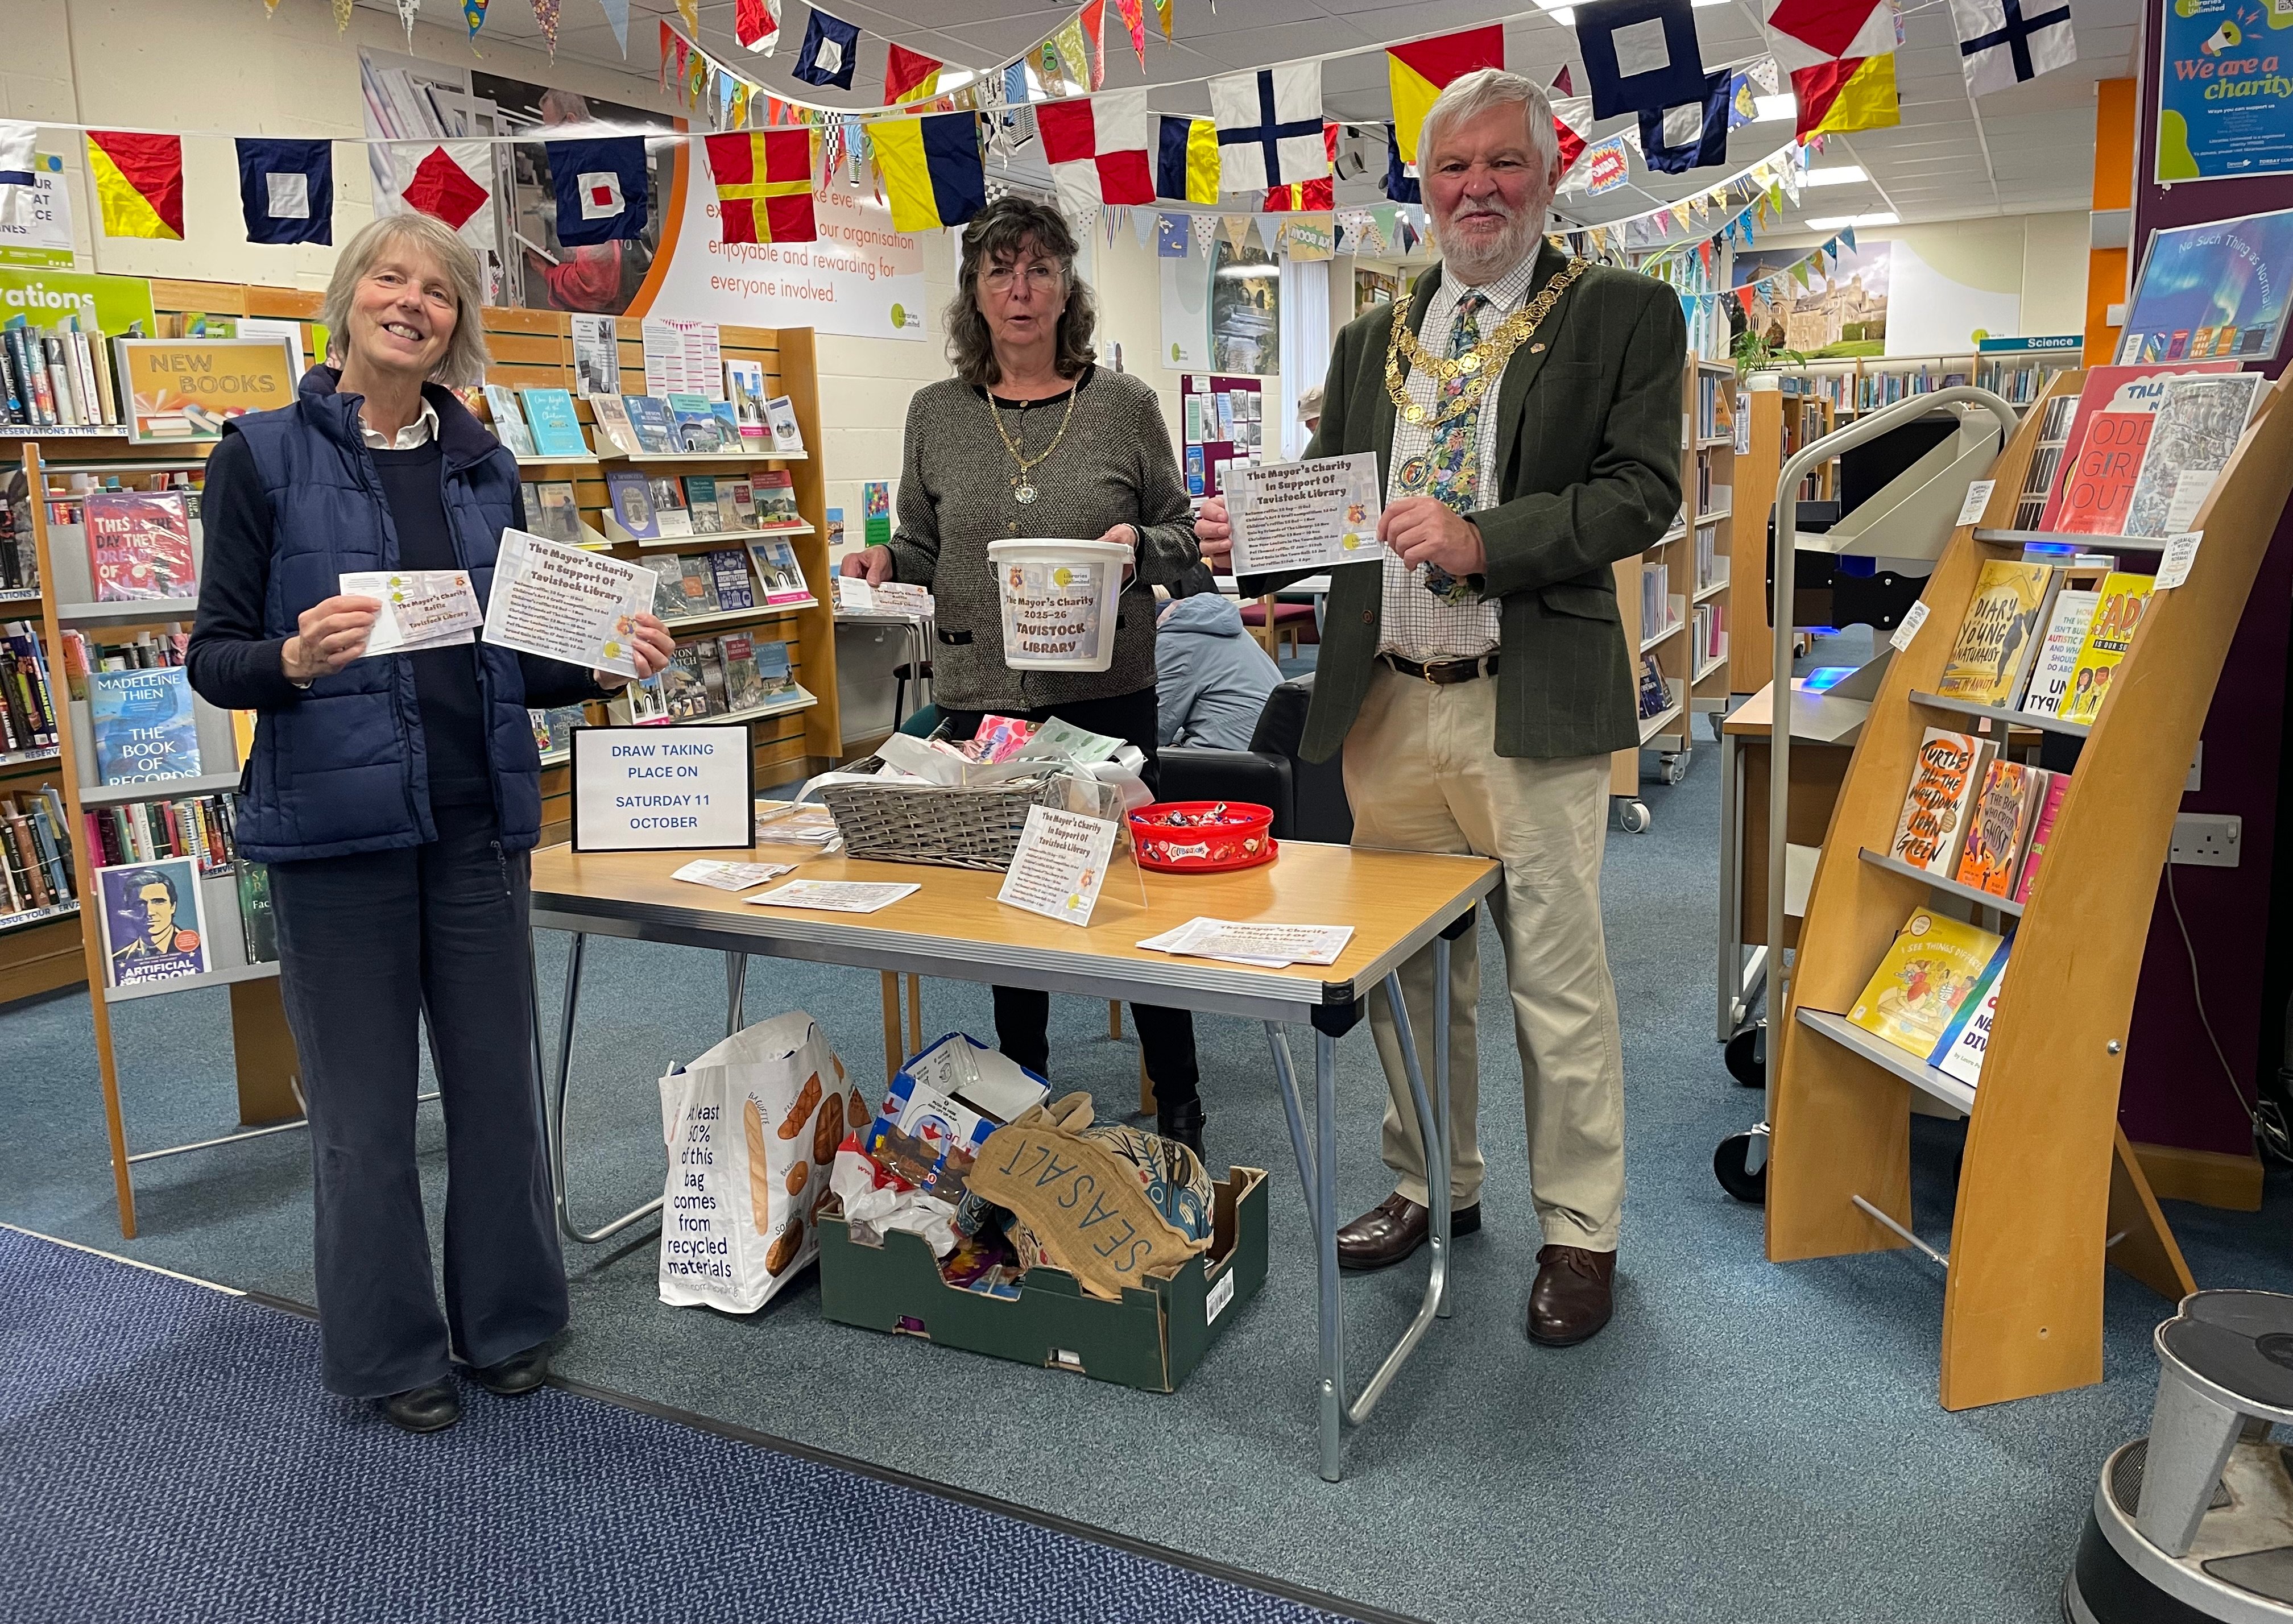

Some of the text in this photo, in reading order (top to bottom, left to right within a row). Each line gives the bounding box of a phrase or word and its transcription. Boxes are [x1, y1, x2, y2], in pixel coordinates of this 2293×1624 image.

[2188, 4, 2225, 14] Unlimited
[2174, 56, 2279, 81] We are a
[2204, 73, 2293, 100] charity
[831, 189, 864, 216] every
[819, 223, 914, 250] our organisation
[2179, 241, 2193, 254] No
[2196, 233, 2221, 247] Such
[2225, 234, 2250, 258] Thing
[2249, 252, 2260, 266] as
[709, 239, 895, 280] enjoyable and rewarding for
[711, 274, 838, 303] everyone involved.
[2027, 338, 2073, 348] Science
[150, 354, 212, 372] NEW
[180, 375, 276, 393] BOOKS
[1247, 459, 1352, 481] The Mayor's Charity
[1265, 474, 1335, 491] In Support Of
[1257, 487, 1347, 505] Tavistock Library
[2073, 483, 2134, 511] OUT
[94, 516, 130, 535] THIS
[96, 533, 157, 549] DAY THEY
[100, 564, 120, 578] OF
[529, 542, 634, 581] The Mayor's Charity
[544, 561, 616, 587] In Support Of
[531, 570, 622, 604] Tavistock Library
[398, 589, 467, 610] The Mayor's Charity
[424, 603, 446, 612] Raffle
[1007, 595, 1094, 608] The Mayor's Charity
[409, 610, 469, 629] Tavistock Library
[1975, 598, 2018, 623] DIARY
[1016, 623, 1086, 636] TAVISTOCK
[1957, 620, 2007, 648] YOUNG
[1023, 640, 1076, 653] LIBRARY
[2048, 635, 2077, 645] AUTISTIC
[2104, 641, 2117, 650] OUR
[2051, 654, 2077, 663] SHOULD
[98, 674, 181, 691] MADELEINE
[119, 689, 163, 701] THIEN
[129, 727, 165, 741] THE
[553, 720, 582, 731] HERONS
[123, 741, 176, 759] BOOK
[612, 744, 714, 757] DRAW TAKING
[1921, 740, 1974, 774] TURTLES
[138, 758, 163, 771] OF
[628, 766, 698, 778] PLACE ON
[1919, 767, 1961, 792] ALL THE
[616, 794, 710, 807] SATURDAY 11
[1908, 786, 1963, 812] WAY DOWN
[1990, 792, 2017, 813] THE BOY
[630, 817, 697, 828] OCTOBER
[1042, 812, 1102, 834] The Mayor's Charity
[1907, 806, 1942, 838] JOHN
[1985, 807, 2015, 831] WHO CRIED
[1055, 827, 1079, 841] Support
[1080, 833, 1089, 843] Of
[1983, 819, 2009, 855] GHOST
[1039, 836, 1091, 858] Tavistock Library
[1896, 832, 1947, 863] GREEN
[25, 908, 51, 919] YOUR
[1907, 943, 1923, 952] SEE
[1927, 942, 1955, 954] THINGS
[125, 959, 194, 977] ARTIFICIAL
[1960, 1055, 1975, 1067] Laura
[748, 1092, 769, 1125] BAGUETTE
[691, 1147, 713, 1165] this
[685, 1169, 705, 1192] bag
[673, 1195, 716, 1209] comes
[999, 1140, 1153, 1273] SEASALT
[679, 1213, 710, 1232] from
[668, 1236, 727, 1258] recycled
[668, 1258, 731, 1278] materials
